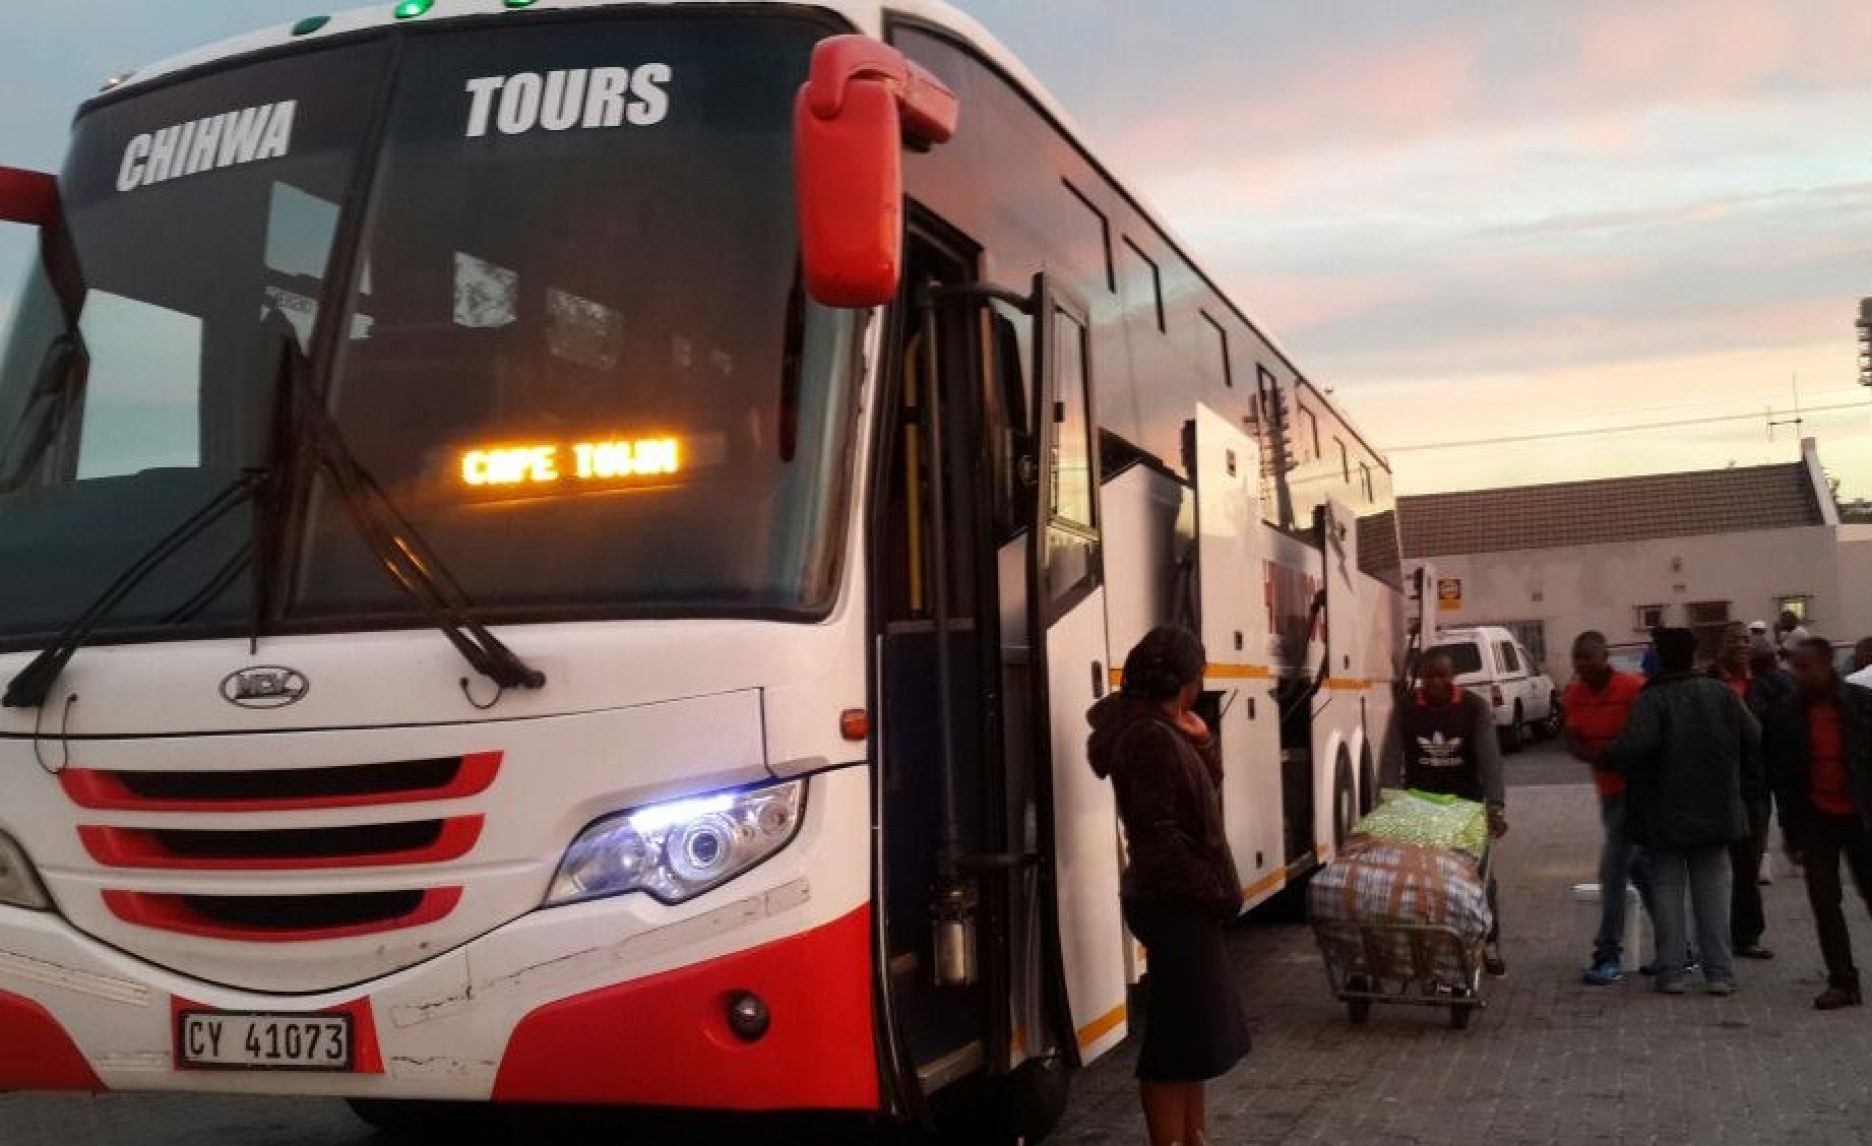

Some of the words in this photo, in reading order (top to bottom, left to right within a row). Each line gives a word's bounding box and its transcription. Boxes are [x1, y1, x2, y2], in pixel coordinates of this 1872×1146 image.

[116, 100, 298, 192] CHIHWA
[464, 62, 673, 137] TOURS
[461, 444, 559, 485] CAPE
[190, 1020, 223, 1057] CY
[246, 1022, 344, 1060] 41073
